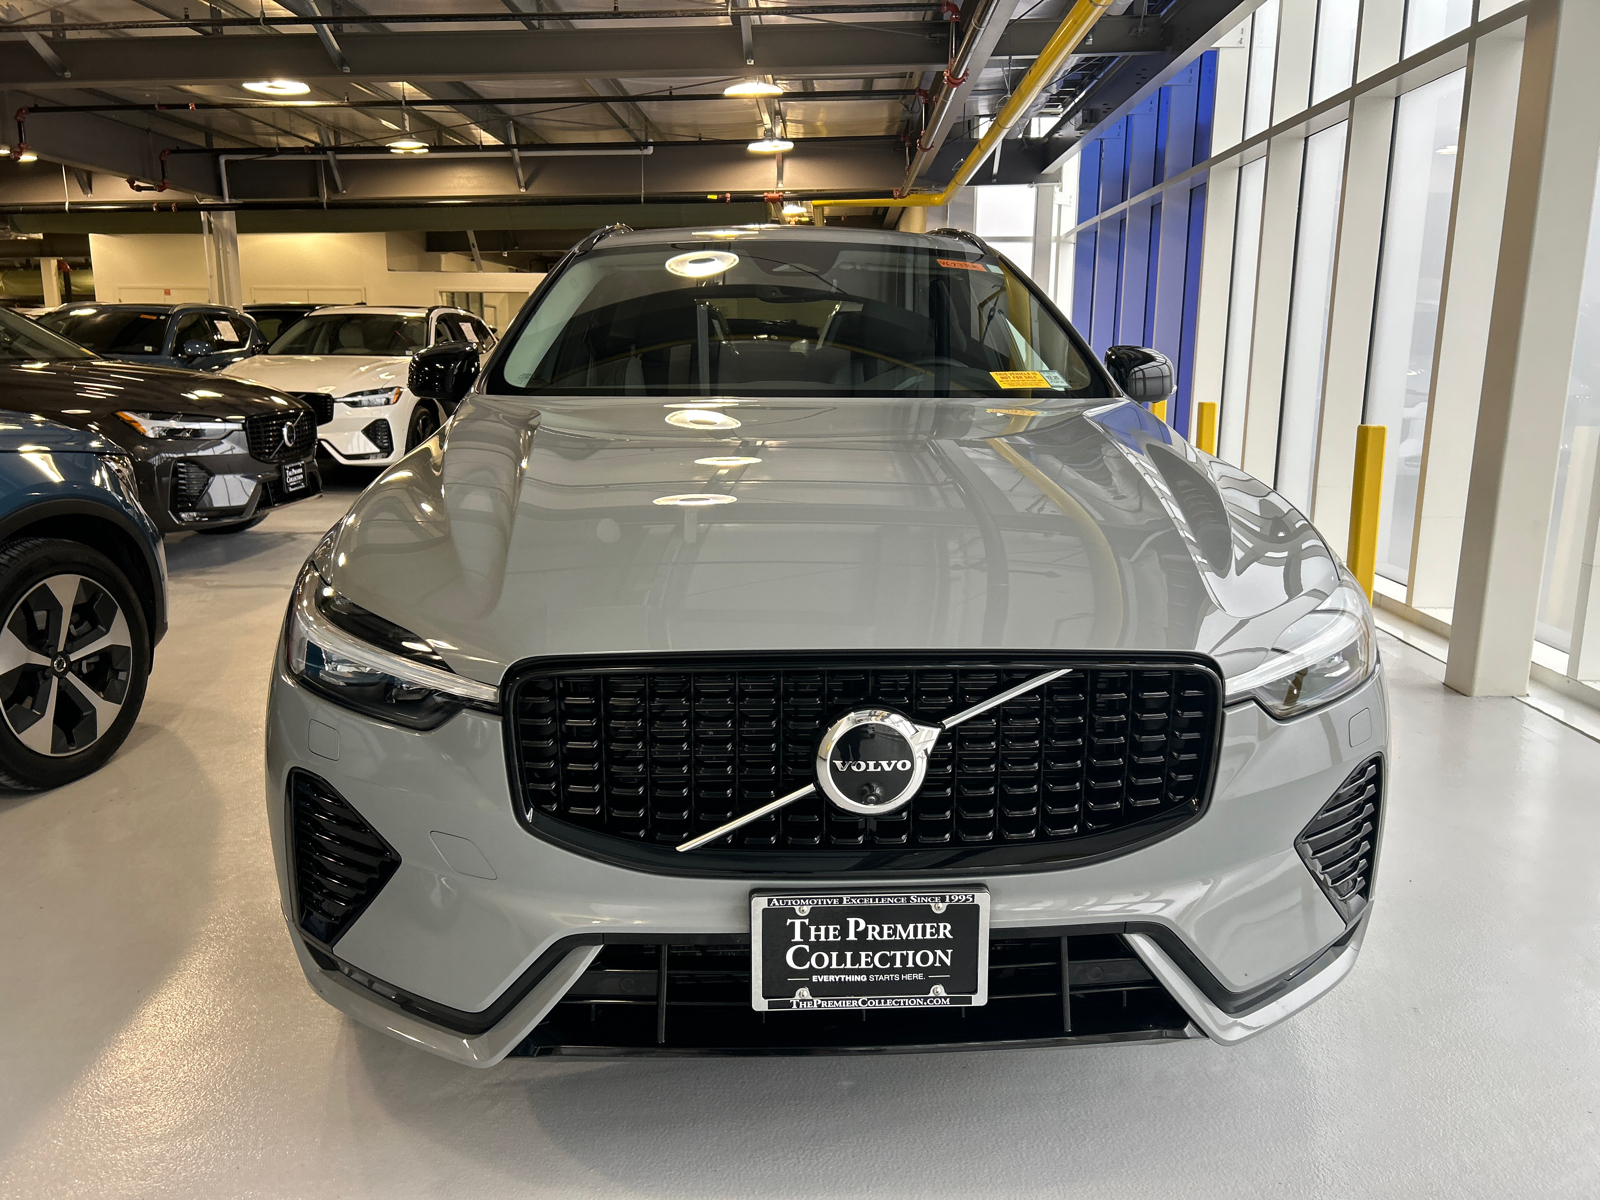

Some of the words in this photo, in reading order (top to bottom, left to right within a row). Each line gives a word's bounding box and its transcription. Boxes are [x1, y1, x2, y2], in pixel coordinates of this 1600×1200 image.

[832, 760, 912, 772] VOLVO
[770, 898, 840, 906] AUTOMOTIVE
[842, 896, 907, 905] EXCELLENCE
[910, 895, 941, 903] SINCE
[944, 894, 973, 902] 1995
[786, 918, 841, 942] THE
[846, 917, 953, 941] PREMIER
[786, 944, 953, 970] COLLECTION
[790, 998, 950, 1009] THEPREMIERCOLLECTION.COM
